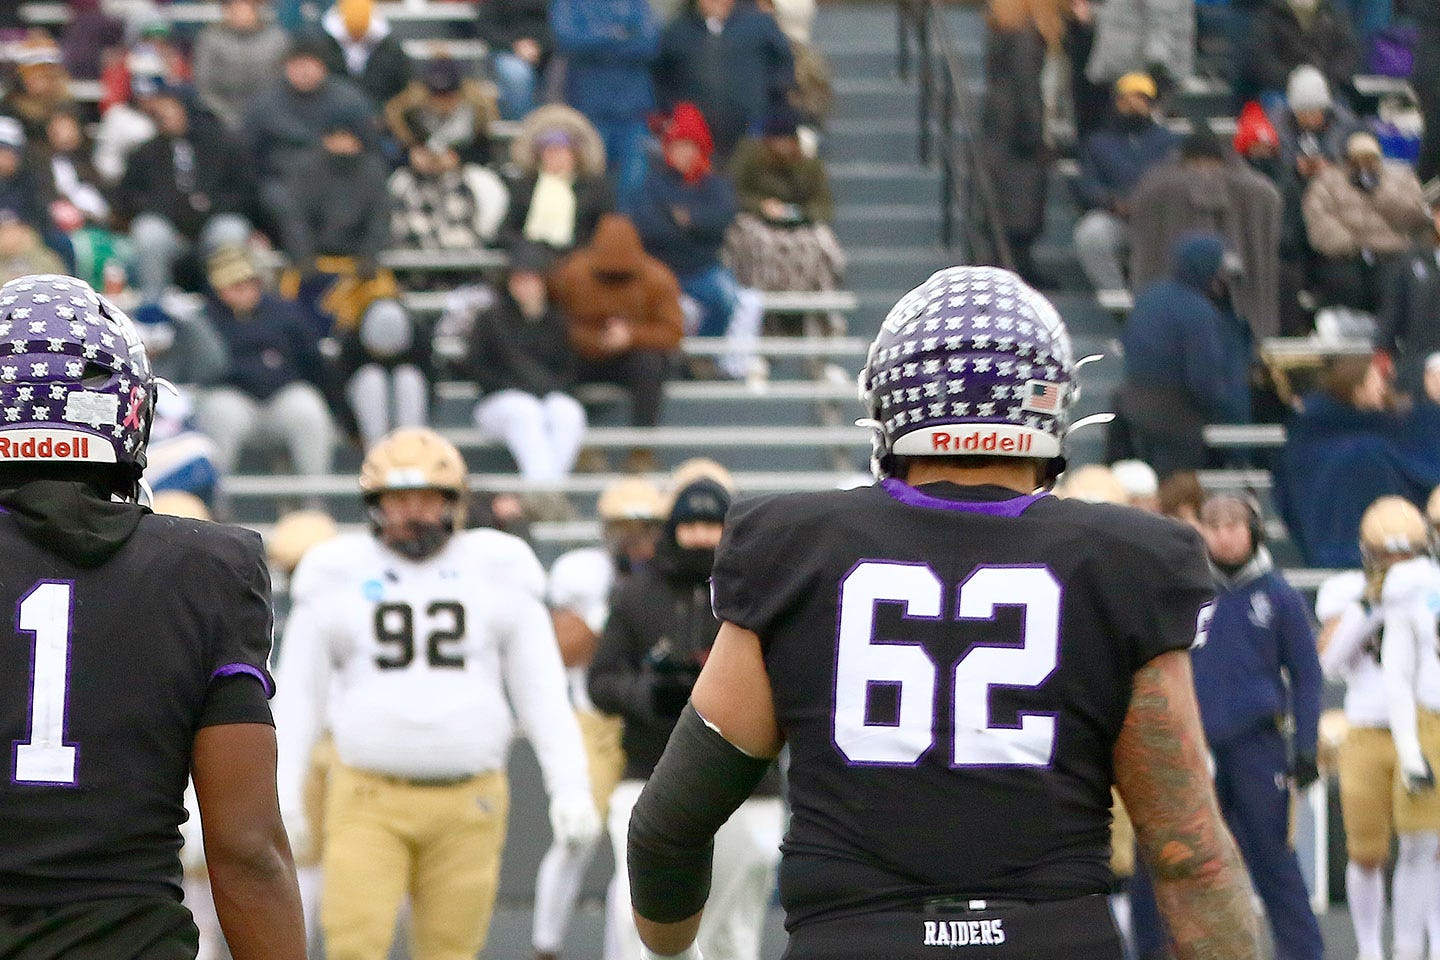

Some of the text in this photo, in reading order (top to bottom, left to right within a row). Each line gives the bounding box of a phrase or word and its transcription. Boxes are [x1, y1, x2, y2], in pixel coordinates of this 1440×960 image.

[932, 431, 1033, 452] Riddell
[374, 602, 466, 670] 92
[832, 559, 1064, 768] 62
[11, 579, 79, 787] 1
[923, 919, 1006, 948] RAIDERS
